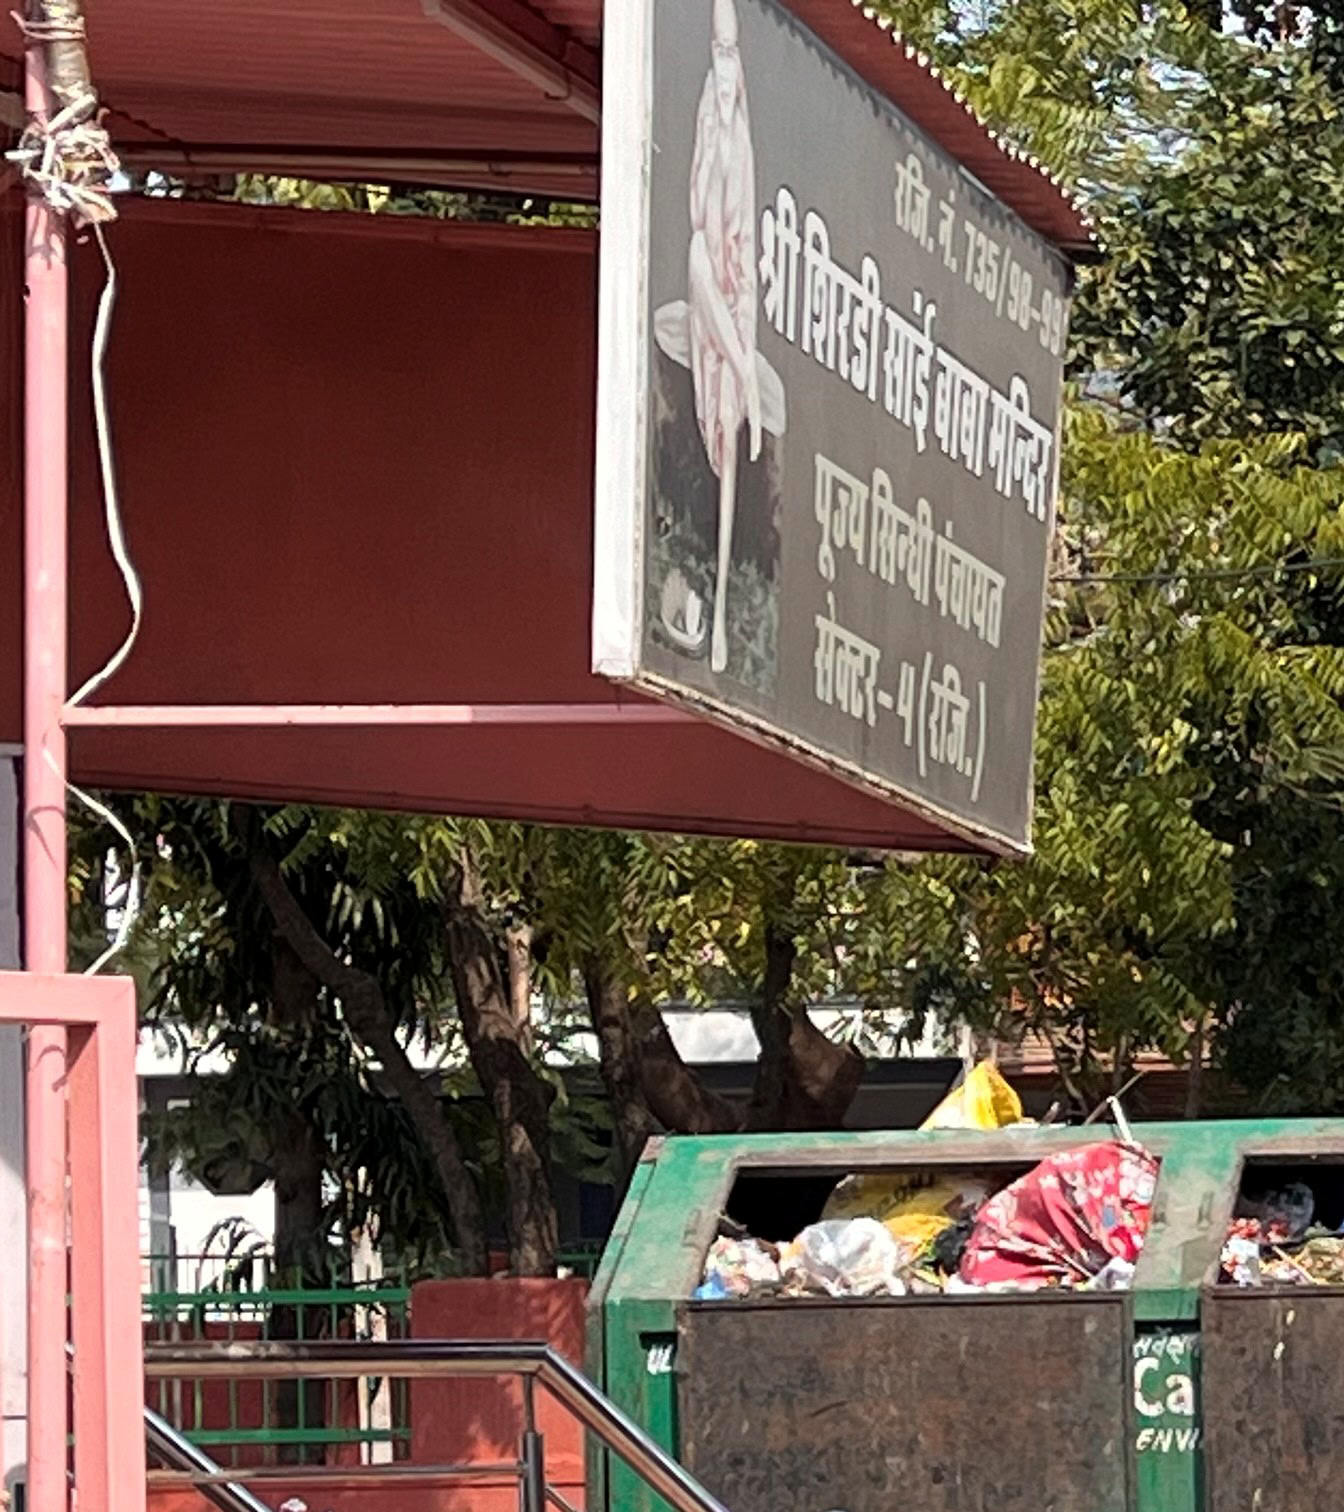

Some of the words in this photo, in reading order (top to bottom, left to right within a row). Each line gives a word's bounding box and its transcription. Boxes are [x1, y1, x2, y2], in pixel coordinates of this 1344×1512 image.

[759, 187, 802, 345] श्री
[801, 210, 884, 402] शिरडी
[934, 345, 991, 479] बाबा
[988, 375, 1055, 523] मन्दिर
[814, 452, 870, 583] पूज्य
[869, 466, 935, 607] सिन्धी
[934, 520, 1007, 650] पंचायत
